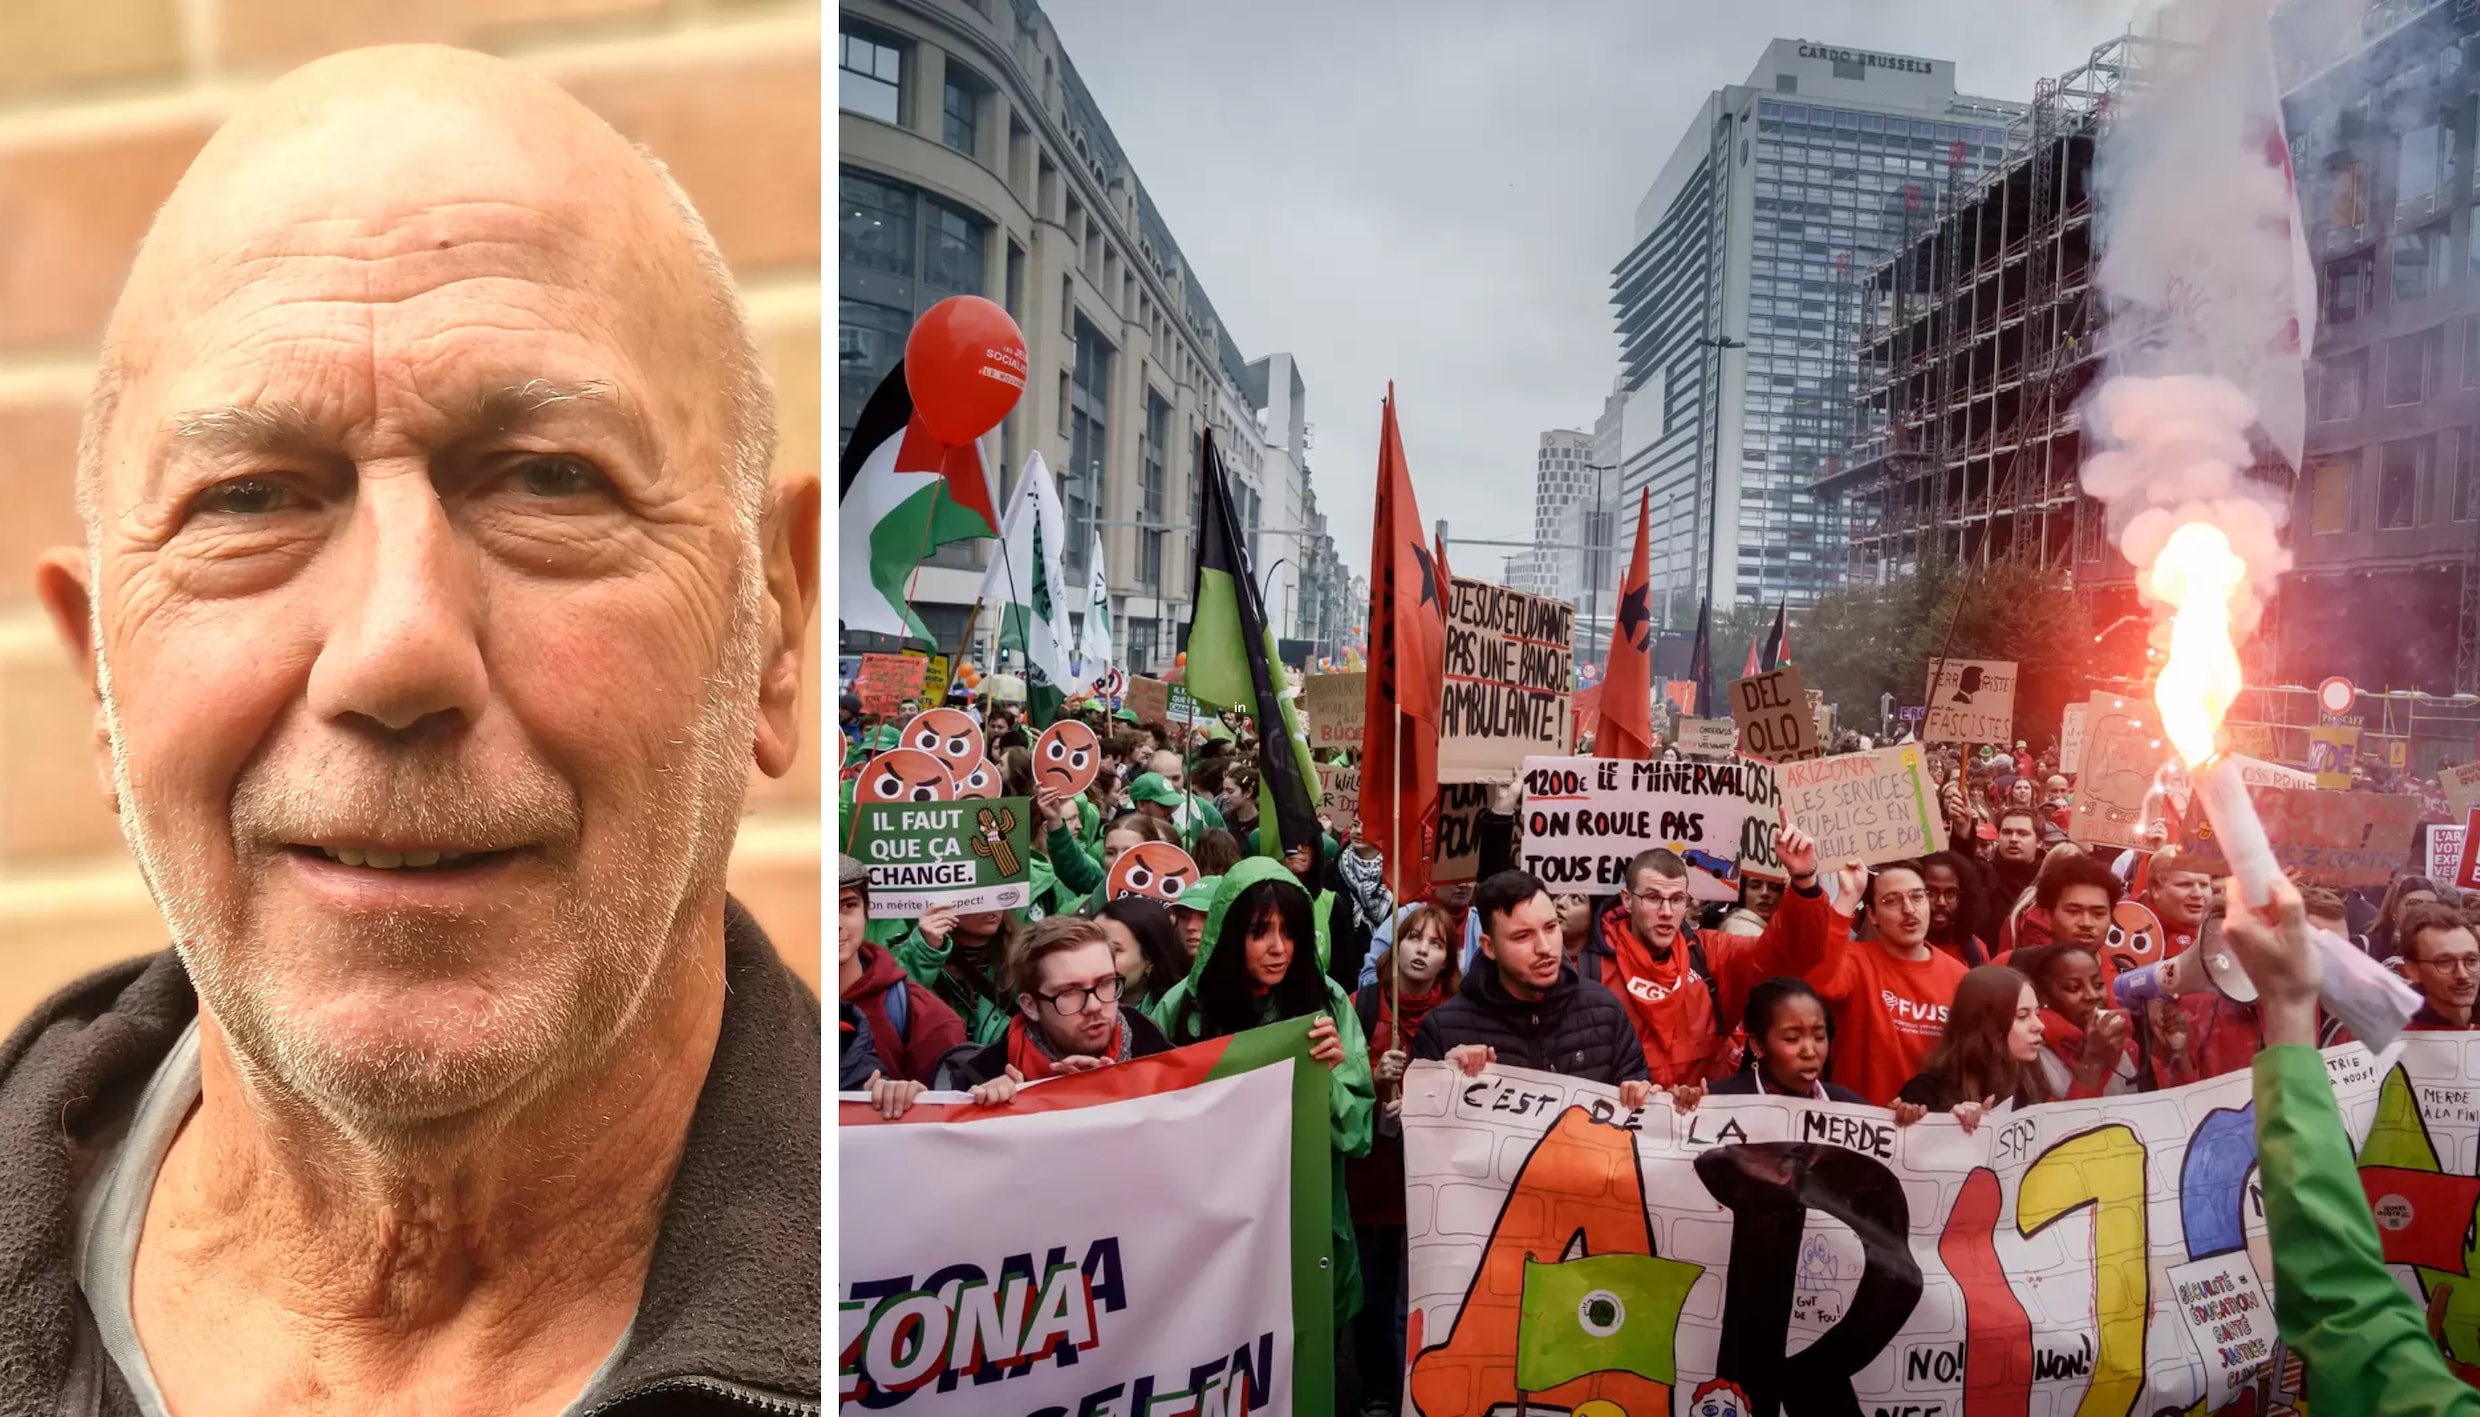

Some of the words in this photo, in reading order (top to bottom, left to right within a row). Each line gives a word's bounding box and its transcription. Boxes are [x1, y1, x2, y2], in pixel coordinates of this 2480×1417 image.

[1798, 45, 1850, 62] CARDO
[1858, 53, 1932, 74] BRUSSELS
[1503, 593, 1573, 647] ETUDIANTE
[1445, 625, 1478, 676] PAS
[1480, 636, 1517, 686] UNE
[1519, 641, 1572, 696] BANQUE
[1741, 671, 1791, 712] DEC
[1441, 682, 1555, 742] AMBULANTE
[1524, 768, 1588, 797] 1200€
[1597, 762, 1619, 791] LE
[1632, 761, 1745, 797] MINERVAL
[1787, 754, 1876, 789] ARIZONA
[1791, 788, 1826, 816] LES
[1832, 770, 1916, 808] SERVICES
[872, 812, 895, 831] IL
[902, 810, 963, 831] FAUT
[1530, 811, 1570, 837] ON
[1576, 809, 1651, 838] ROULE
[1660, 811, 1704, 842] PAS
[1796, 806, 1878, 837] PUBLICS
[1886, 802, 1910, 822] EN
[871, 839, 921, 861] QUE
[928, 837, 962, 863] ÇA
[1813, 835, 1860, 861] UEULE
[1866, 829, 1890, 856] DE
[869, 864, 974, 885] CHANGE.
[1525, 854, 1592, 883] TOUS
[887, 898, 920, 910] mérite
[1899, 998, 1950, 1024] FVJS
[2344, 1066, 2376, 1084] NOUS!
[2424, 1088, 2471, 1104] MERDE
[1463, 1079, 1557, 1117] C'EST
[1589, 1099, 1646, 1131] DE
[1687, 1116, 1748, 1145] LA
[1803, 1110, 1896, 1160] MERDE
[2424, 1107, 2432, 1119] À
[2434, 1109, 2450, 1119] LA
[2179, 1270, 2235, 1304] SÉCURITÉ
[1794, 1310, 1806, 1321] DE
[2189, 1290, 2260, 1326] ÉDUCATION
[2212, 1314, 2252, 1344] SANTÉ
[1907, 1342, 1964, 1383] NO!
[2034, 1333, 2092, 1381] NON!
[2218, 1338, 2268, 1368] JUSTICE
